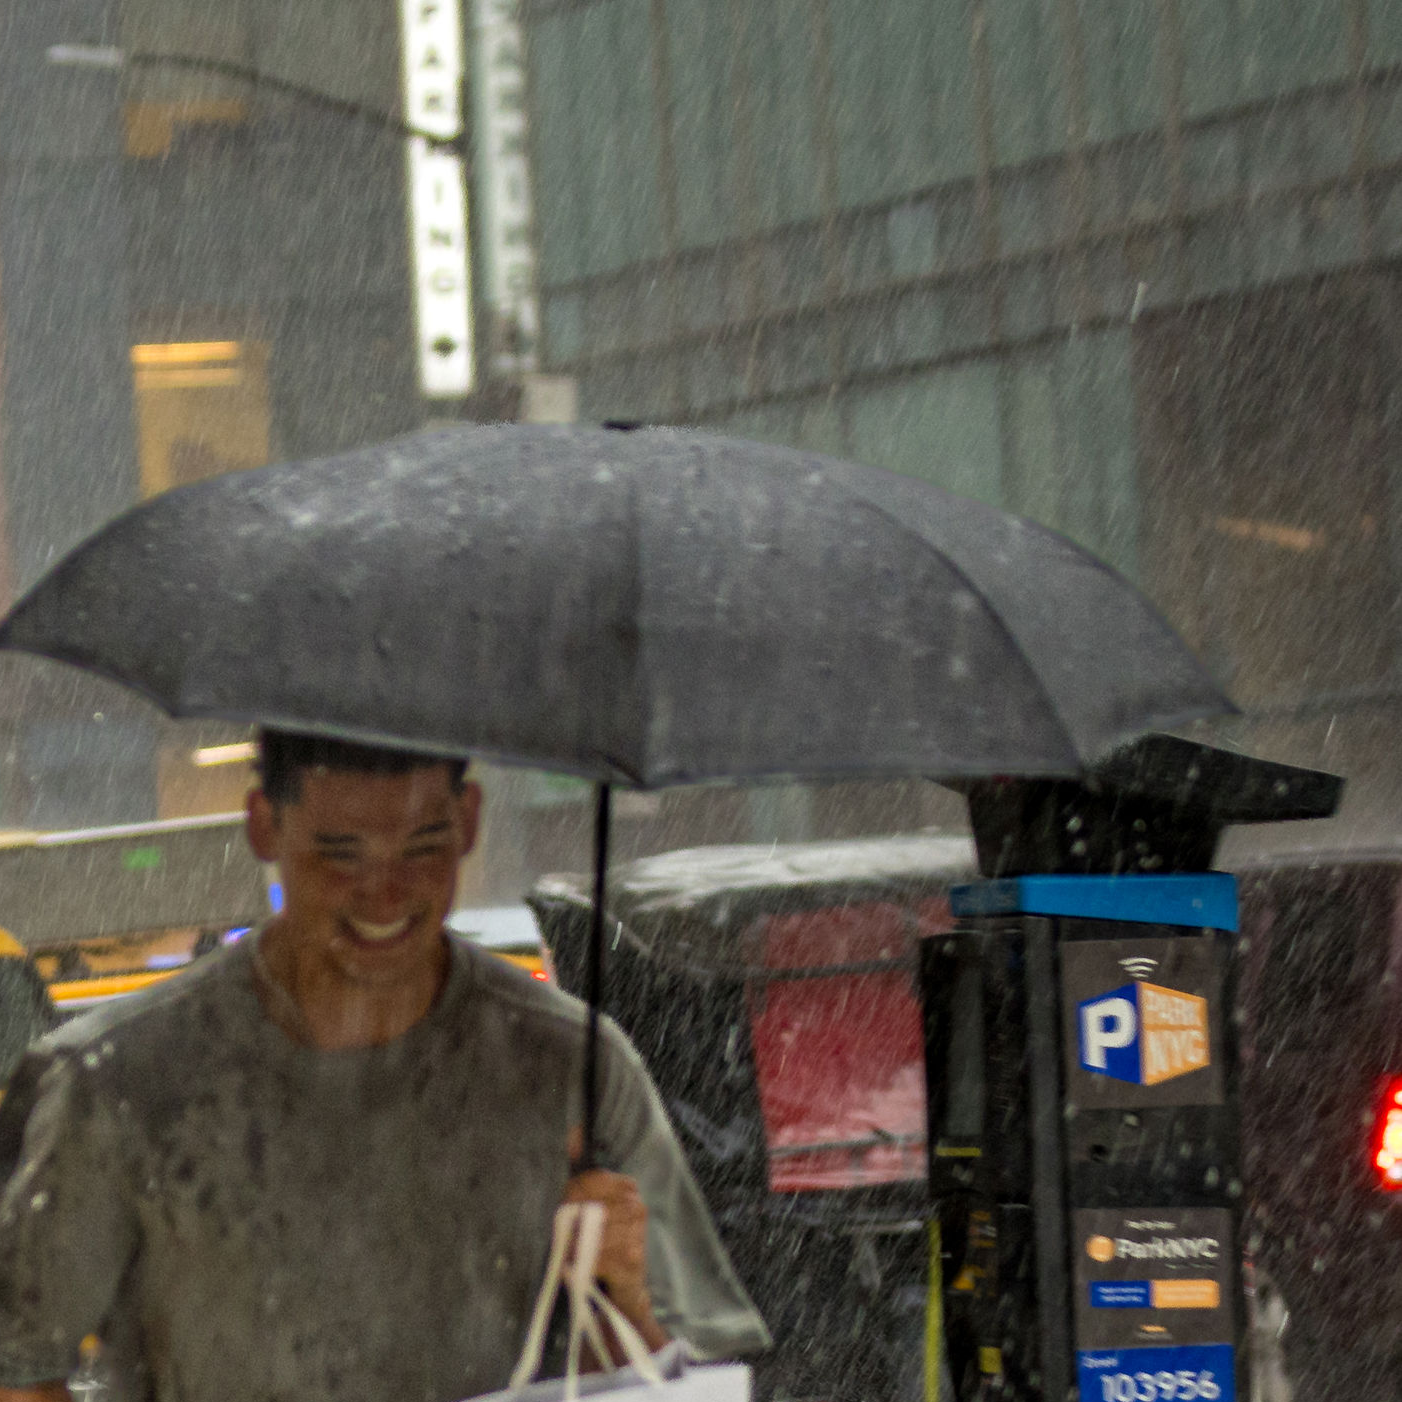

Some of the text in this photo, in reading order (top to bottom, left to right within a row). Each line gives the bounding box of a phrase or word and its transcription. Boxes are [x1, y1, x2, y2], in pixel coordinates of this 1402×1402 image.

[417, 3, 457, 297] PARING
[1080, 997, 1137, 1070] P
[1145, 1028, 1207, 1076] NYC
[1114, 1236, 1220, 1260] ParkNYC
